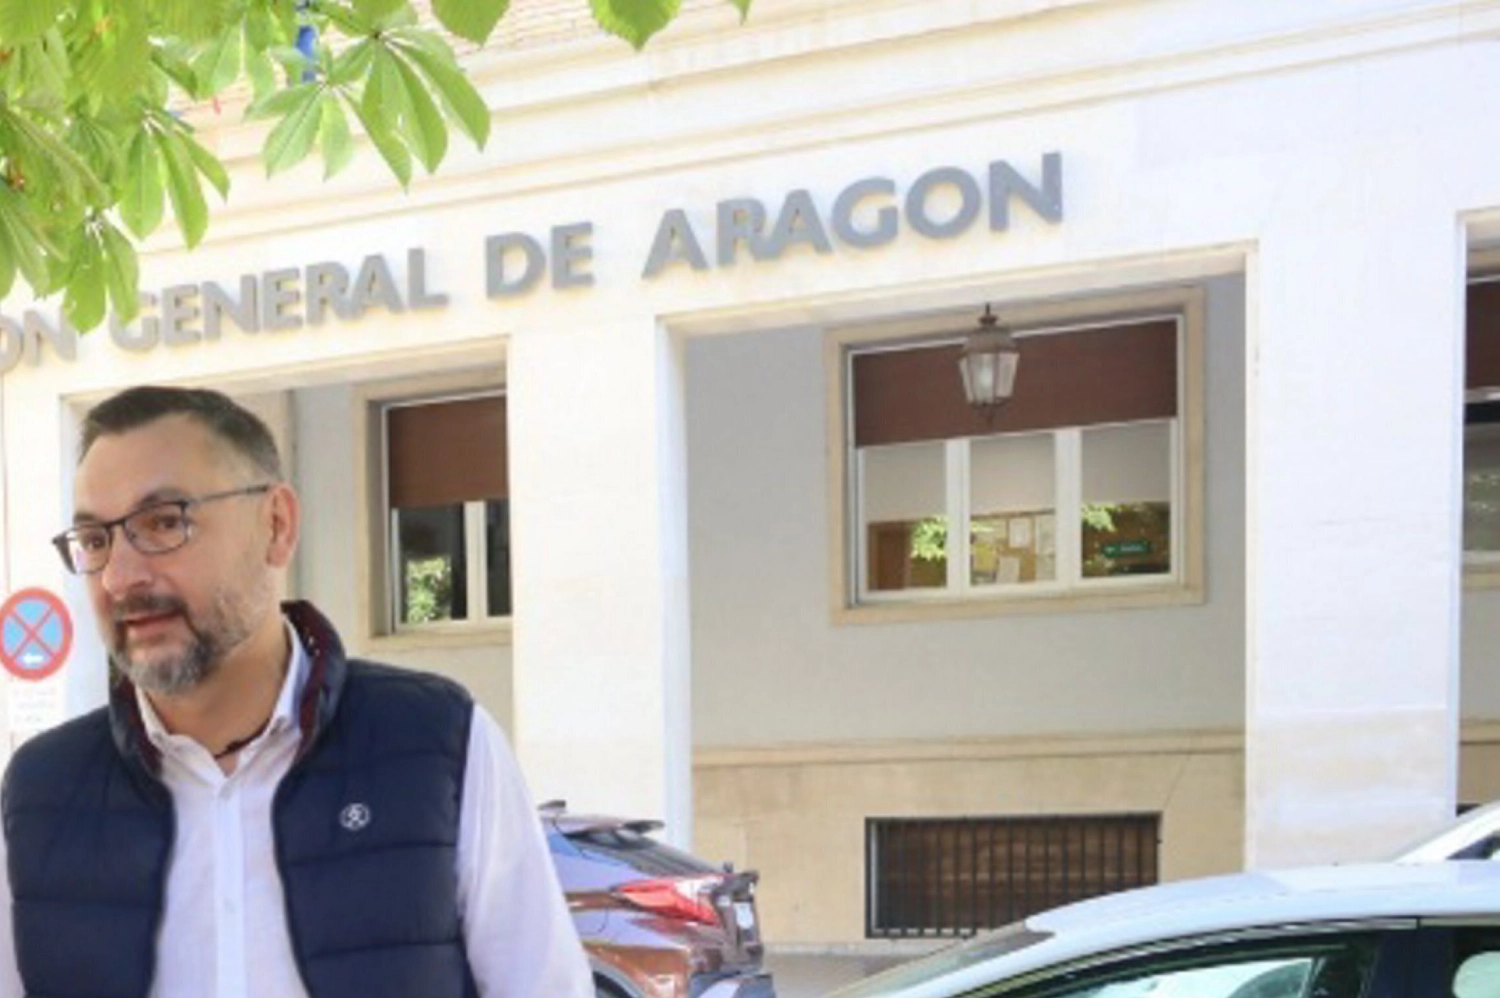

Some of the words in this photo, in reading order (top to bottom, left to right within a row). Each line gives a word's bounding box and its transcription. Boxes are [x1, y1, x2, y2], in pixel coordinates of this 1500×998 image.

[109, 248, 449, 351] GENERAL
[485, 221, 595, 300] DE
[641, 151, 1062, 279] ARAGON
